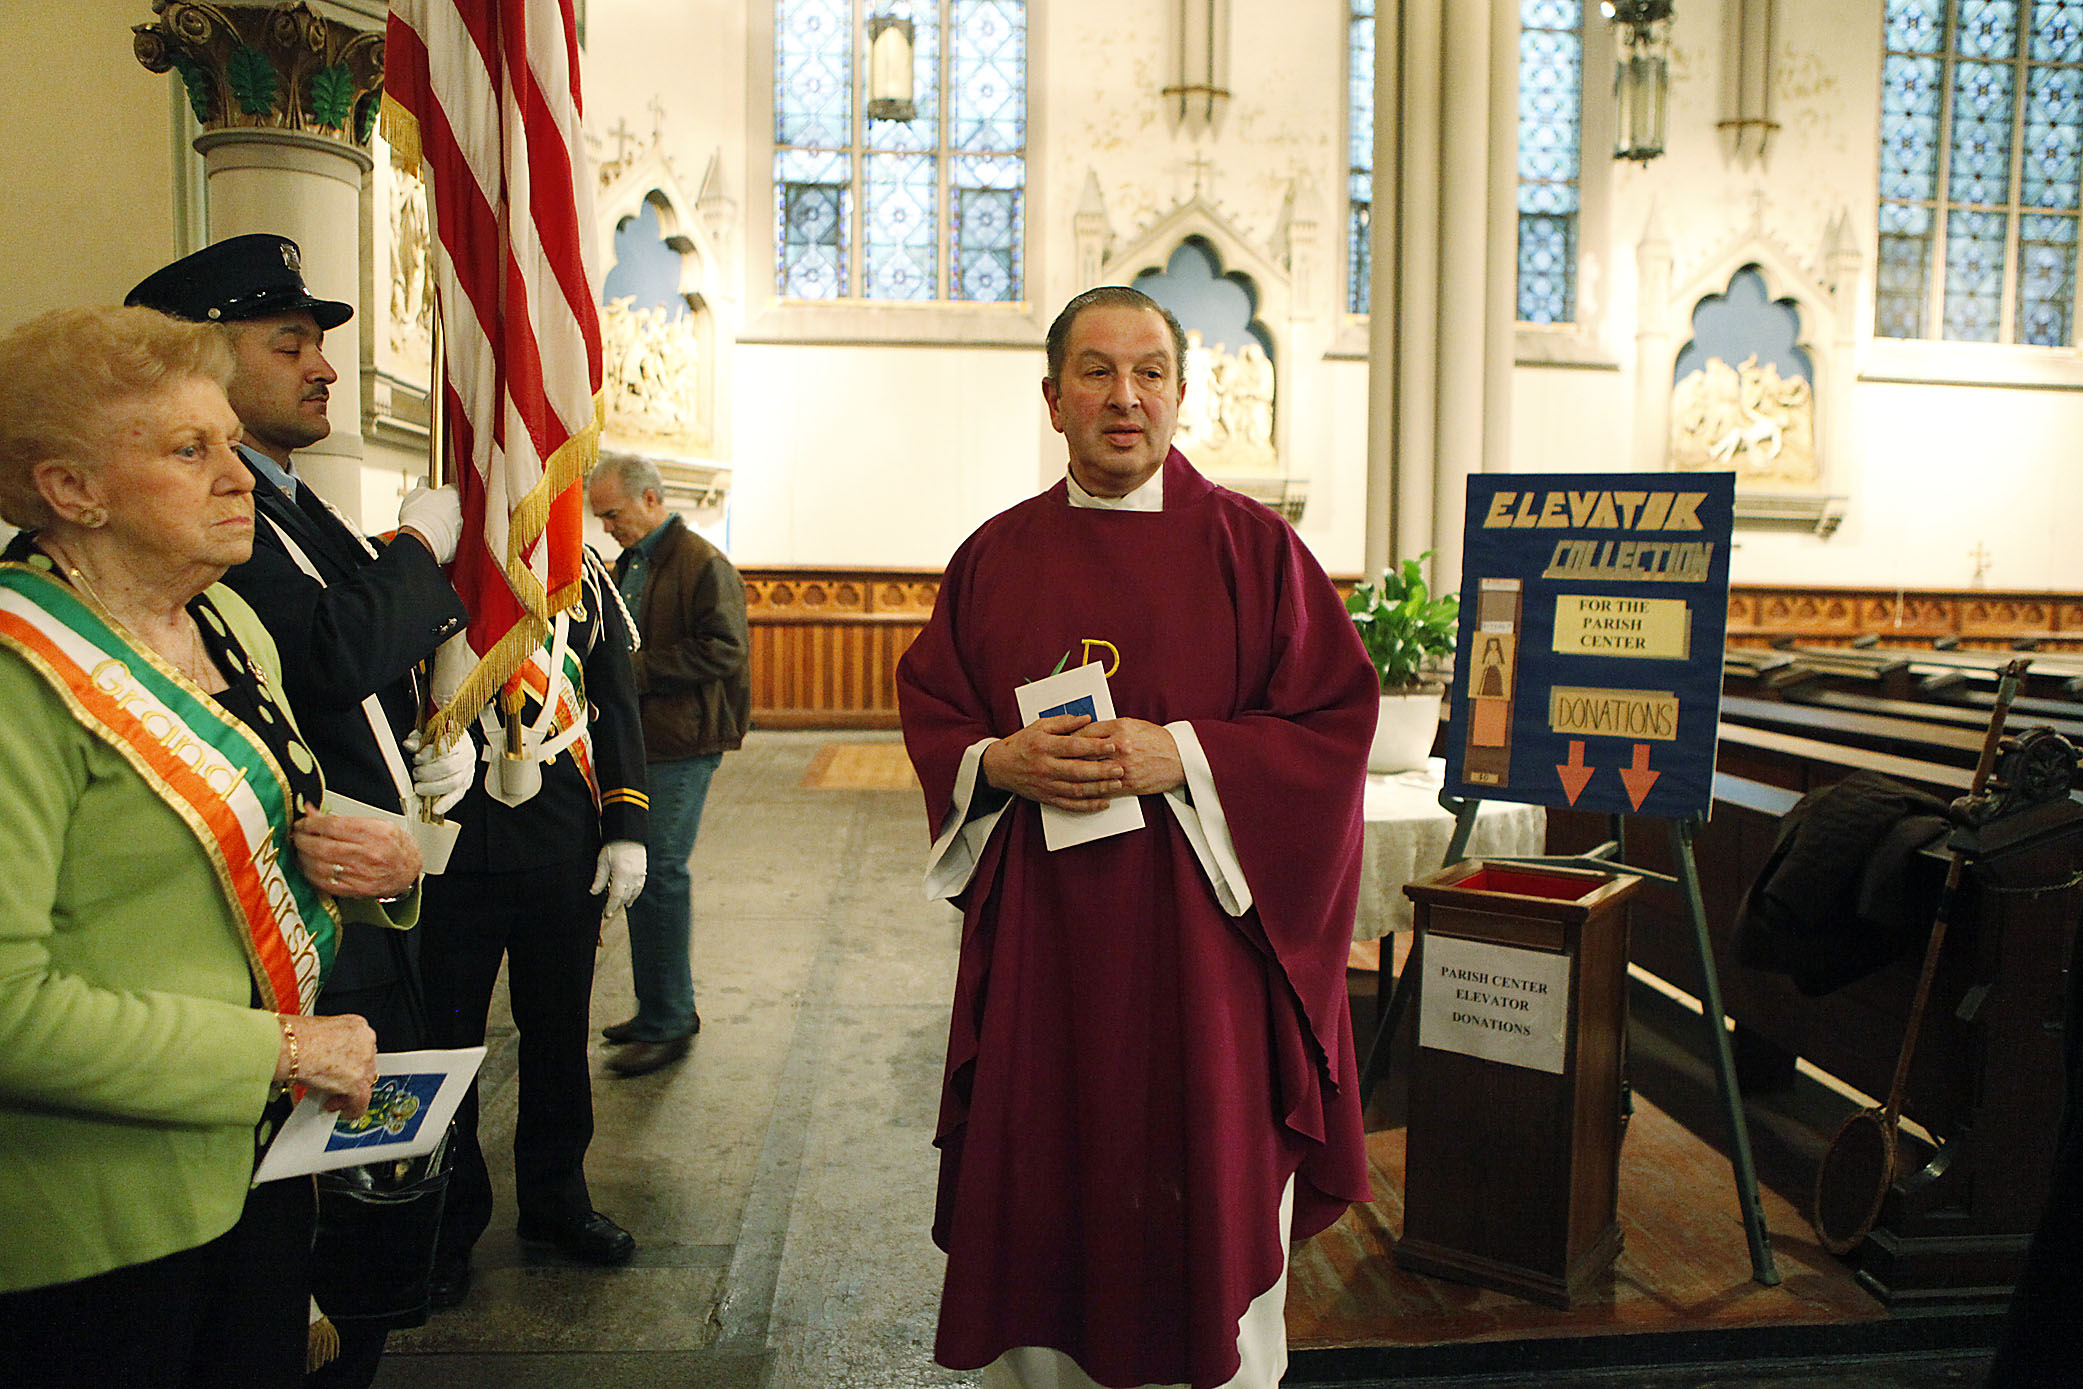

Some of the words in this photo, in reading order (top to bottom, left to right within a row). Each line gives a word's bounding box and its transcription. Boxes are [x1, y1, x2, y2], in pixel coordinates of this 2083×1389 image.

[1542, 540, 1714, 582] COLLECTION
[1580, 599, 1611, 612] FOR
[1616, 600, 1650, 614] THE
[1583, 617, 1642, 631] PARISH
[1580, 634, 1646, 649] CENTER
[91, 659, 248, 801] Grand
[1558, 697, 1673, 737] DONATIONS
[1441, 966, 1488, 984] PARISH
[1492, 975, 1548, 995] CENTER
[1456, 988, 1529, 1011] ELEVATOR
[1452, 1011, 1531, 1037] DONATIONS
